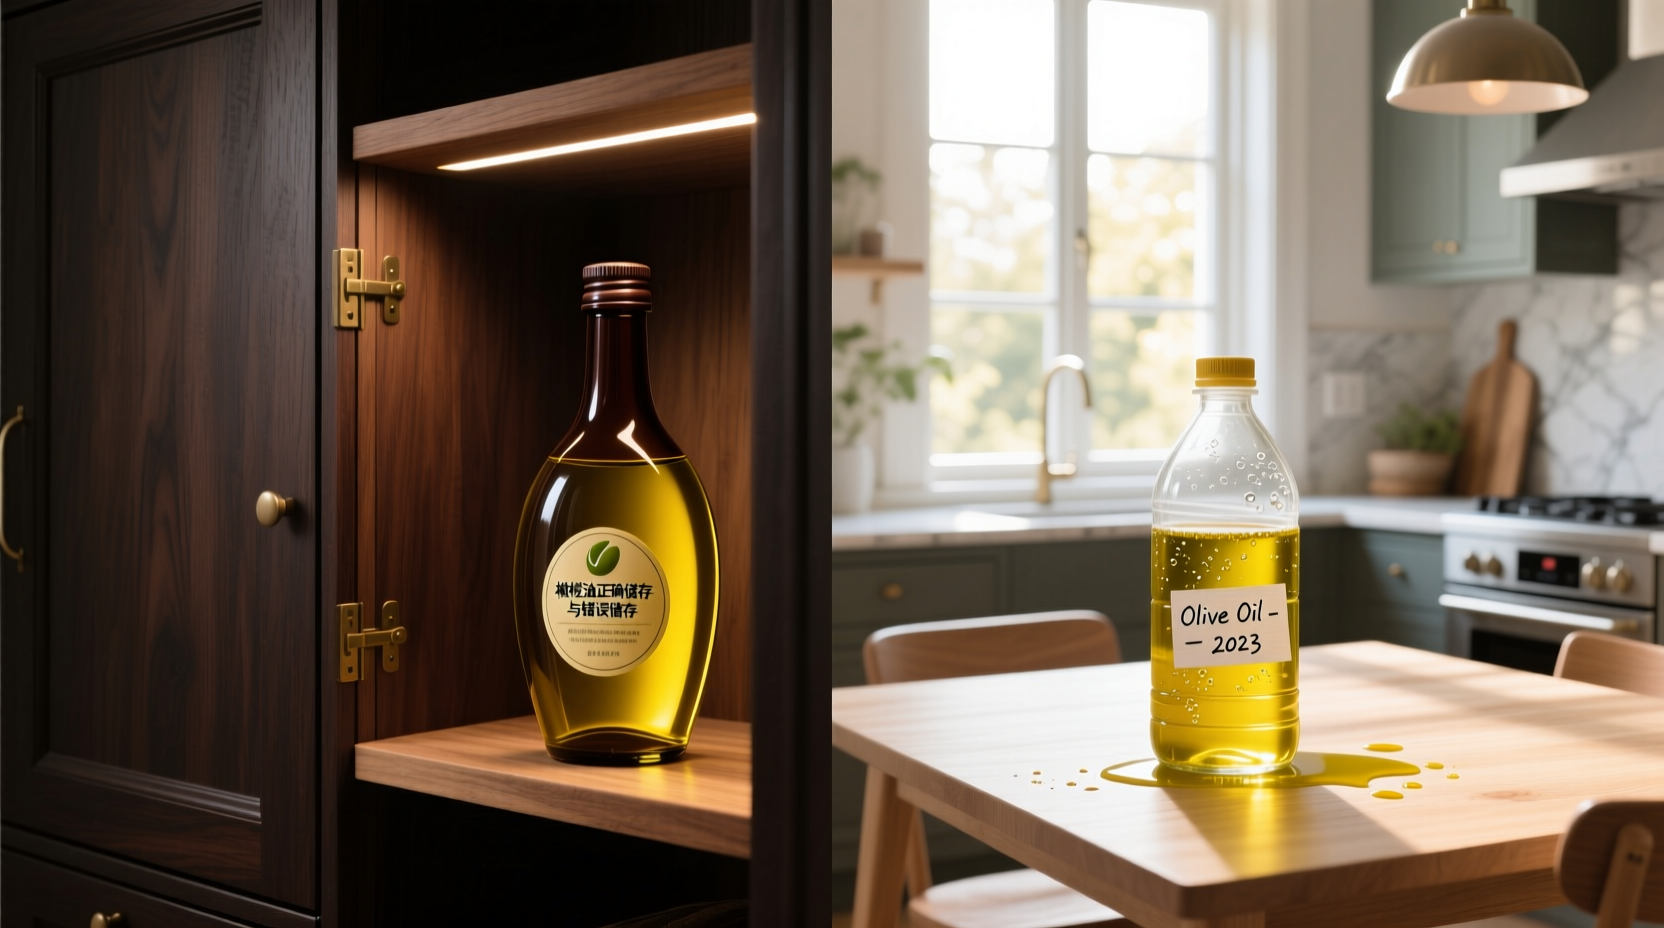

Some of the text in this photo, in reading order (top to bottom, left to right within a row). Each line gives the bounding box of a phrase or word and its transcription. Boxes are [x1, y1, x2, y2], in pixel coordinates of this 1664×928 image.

[1181, 604, 1229, 626] Olive
[1237, 599, 1263, 623] Oil
[1211, 633, 1262, 654] 2023
